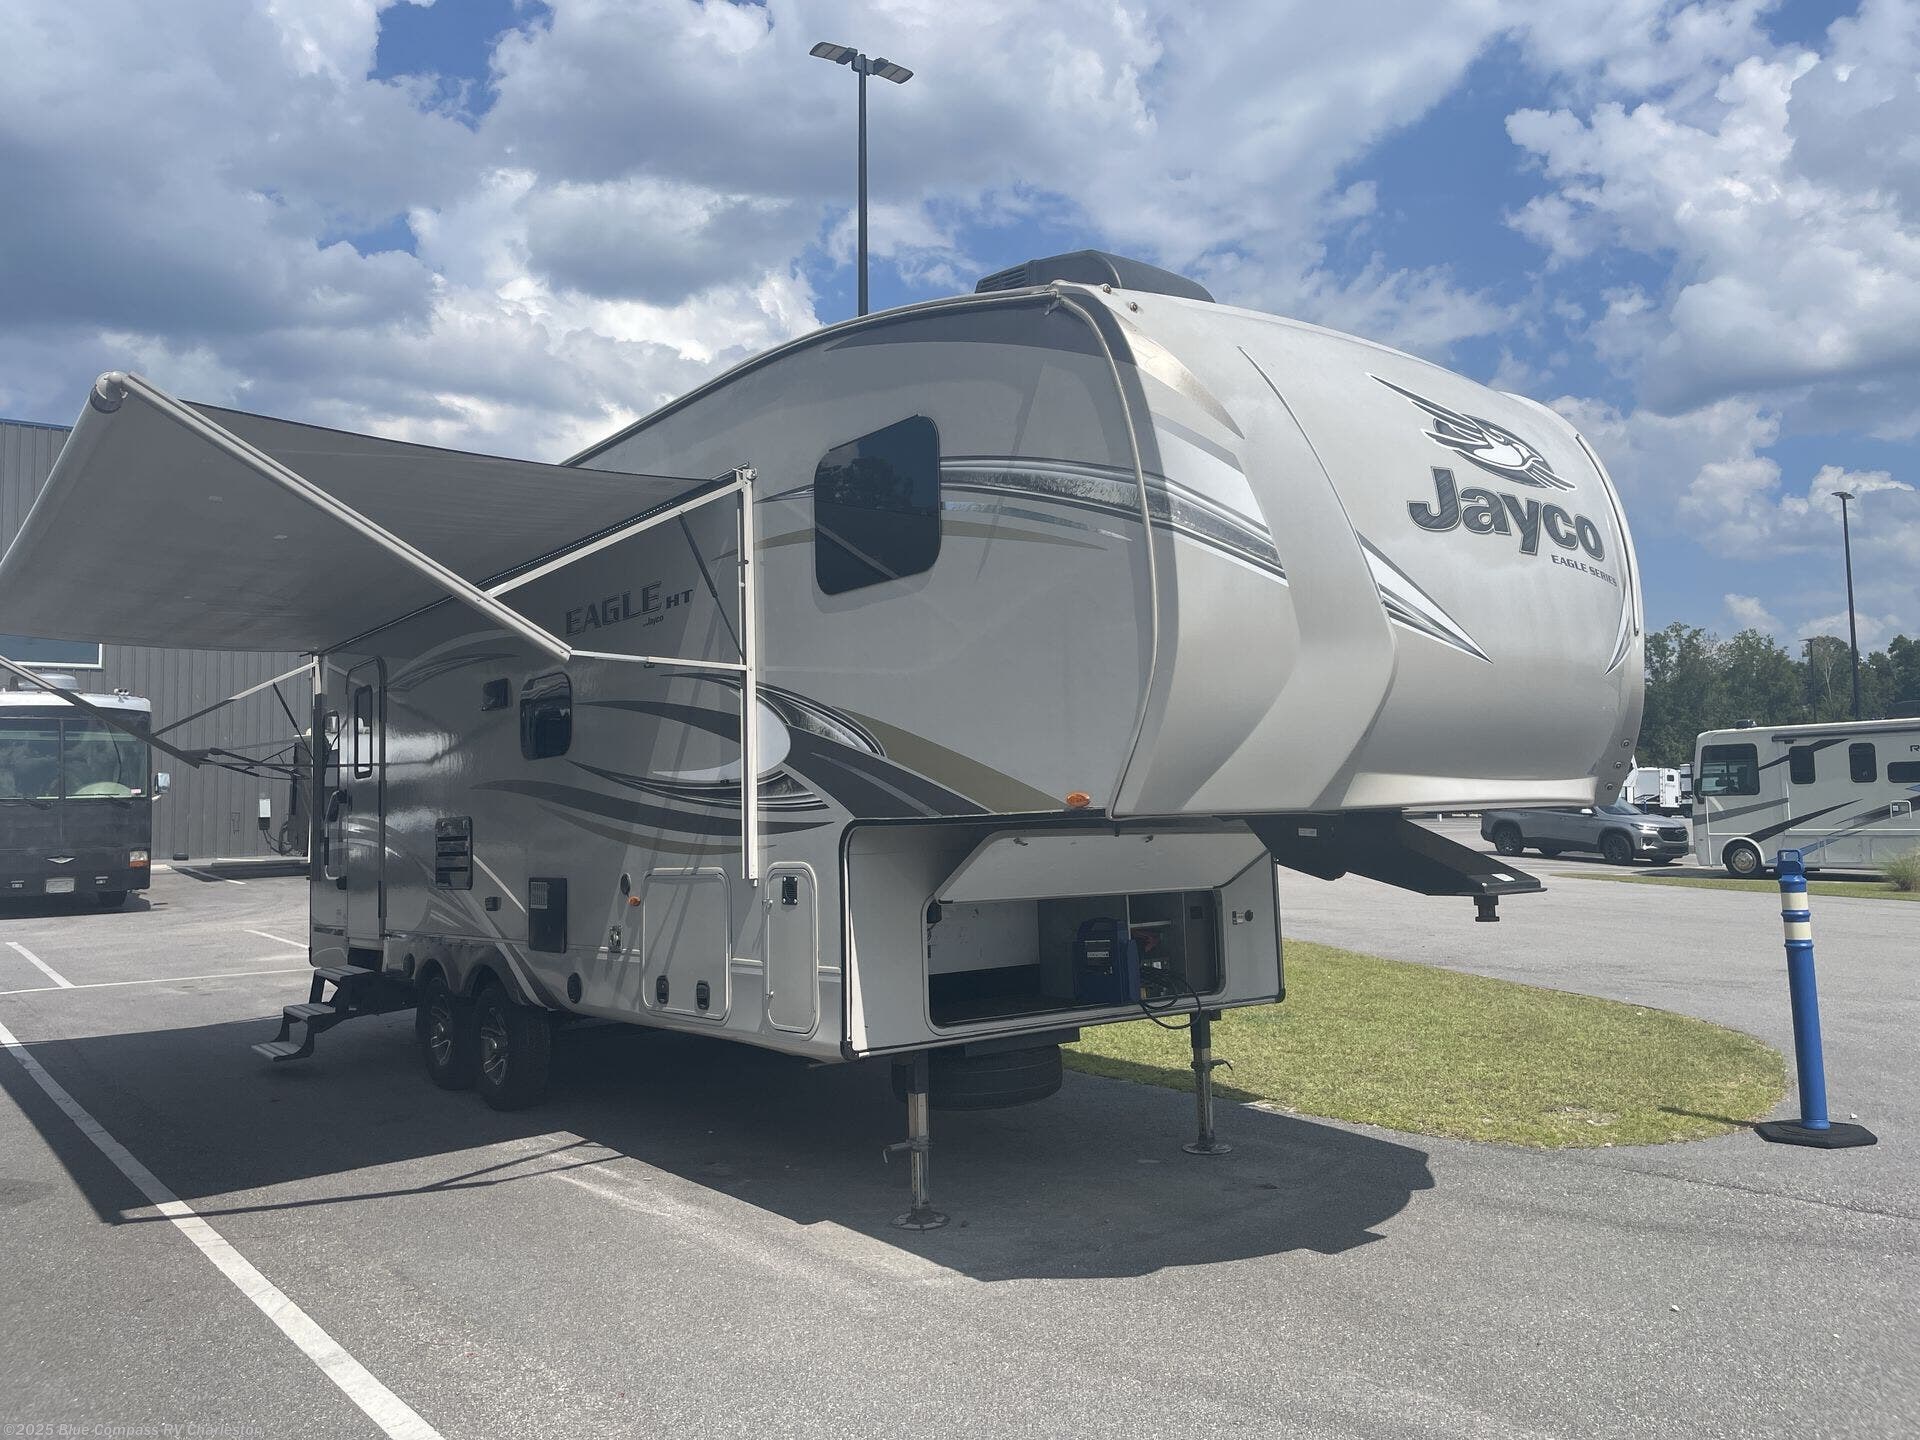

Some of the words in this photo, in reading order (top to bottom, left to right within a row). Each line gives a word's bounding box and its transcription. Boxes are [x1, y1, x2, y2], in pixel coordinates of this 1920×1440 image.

[1407, 466, 1605, 562] Jayco
[1551, 554, 1588, 573] EAGLE
[1588, 566, 1617, 587] SERIES
[566, 581, 662, 636] EAGLE
[666, 589, 694, 609] HT
